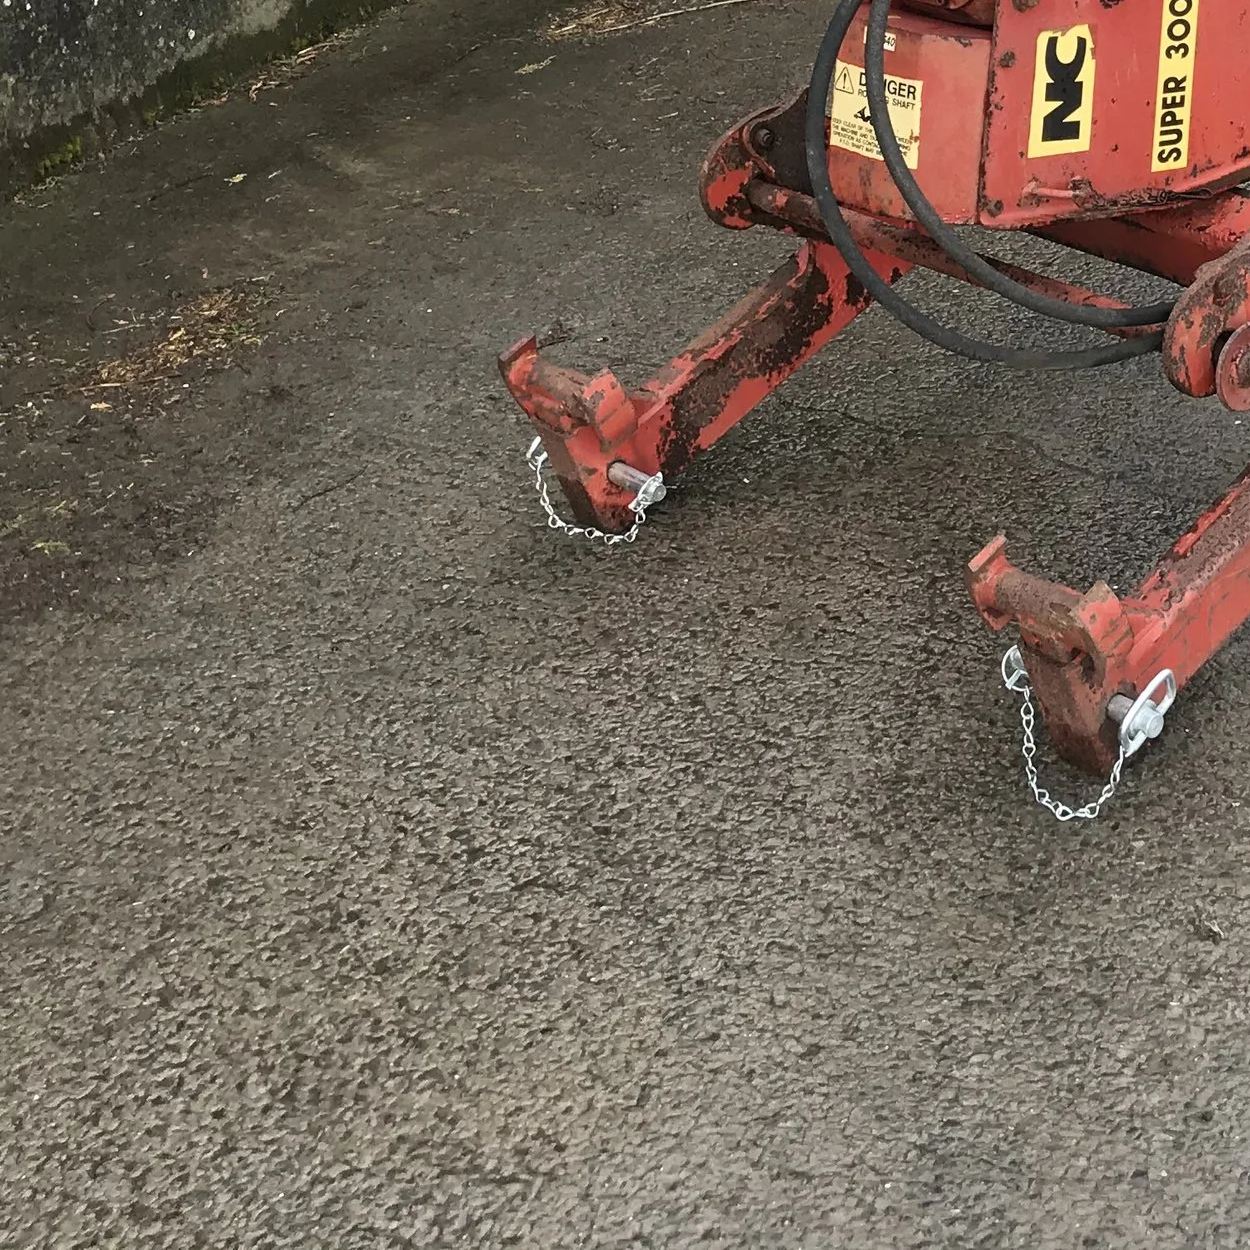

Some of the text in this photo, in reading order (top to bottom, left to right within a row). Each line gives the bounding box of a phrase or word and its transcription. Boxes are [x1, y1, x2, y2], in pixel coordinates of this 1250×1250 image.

[859, 72, 917, 100] DGER
[892, 98, 916, 110] SHAFT
[1041, 36, 1087, 142] NC
[1157, 75, 1187, 164] SUPER
